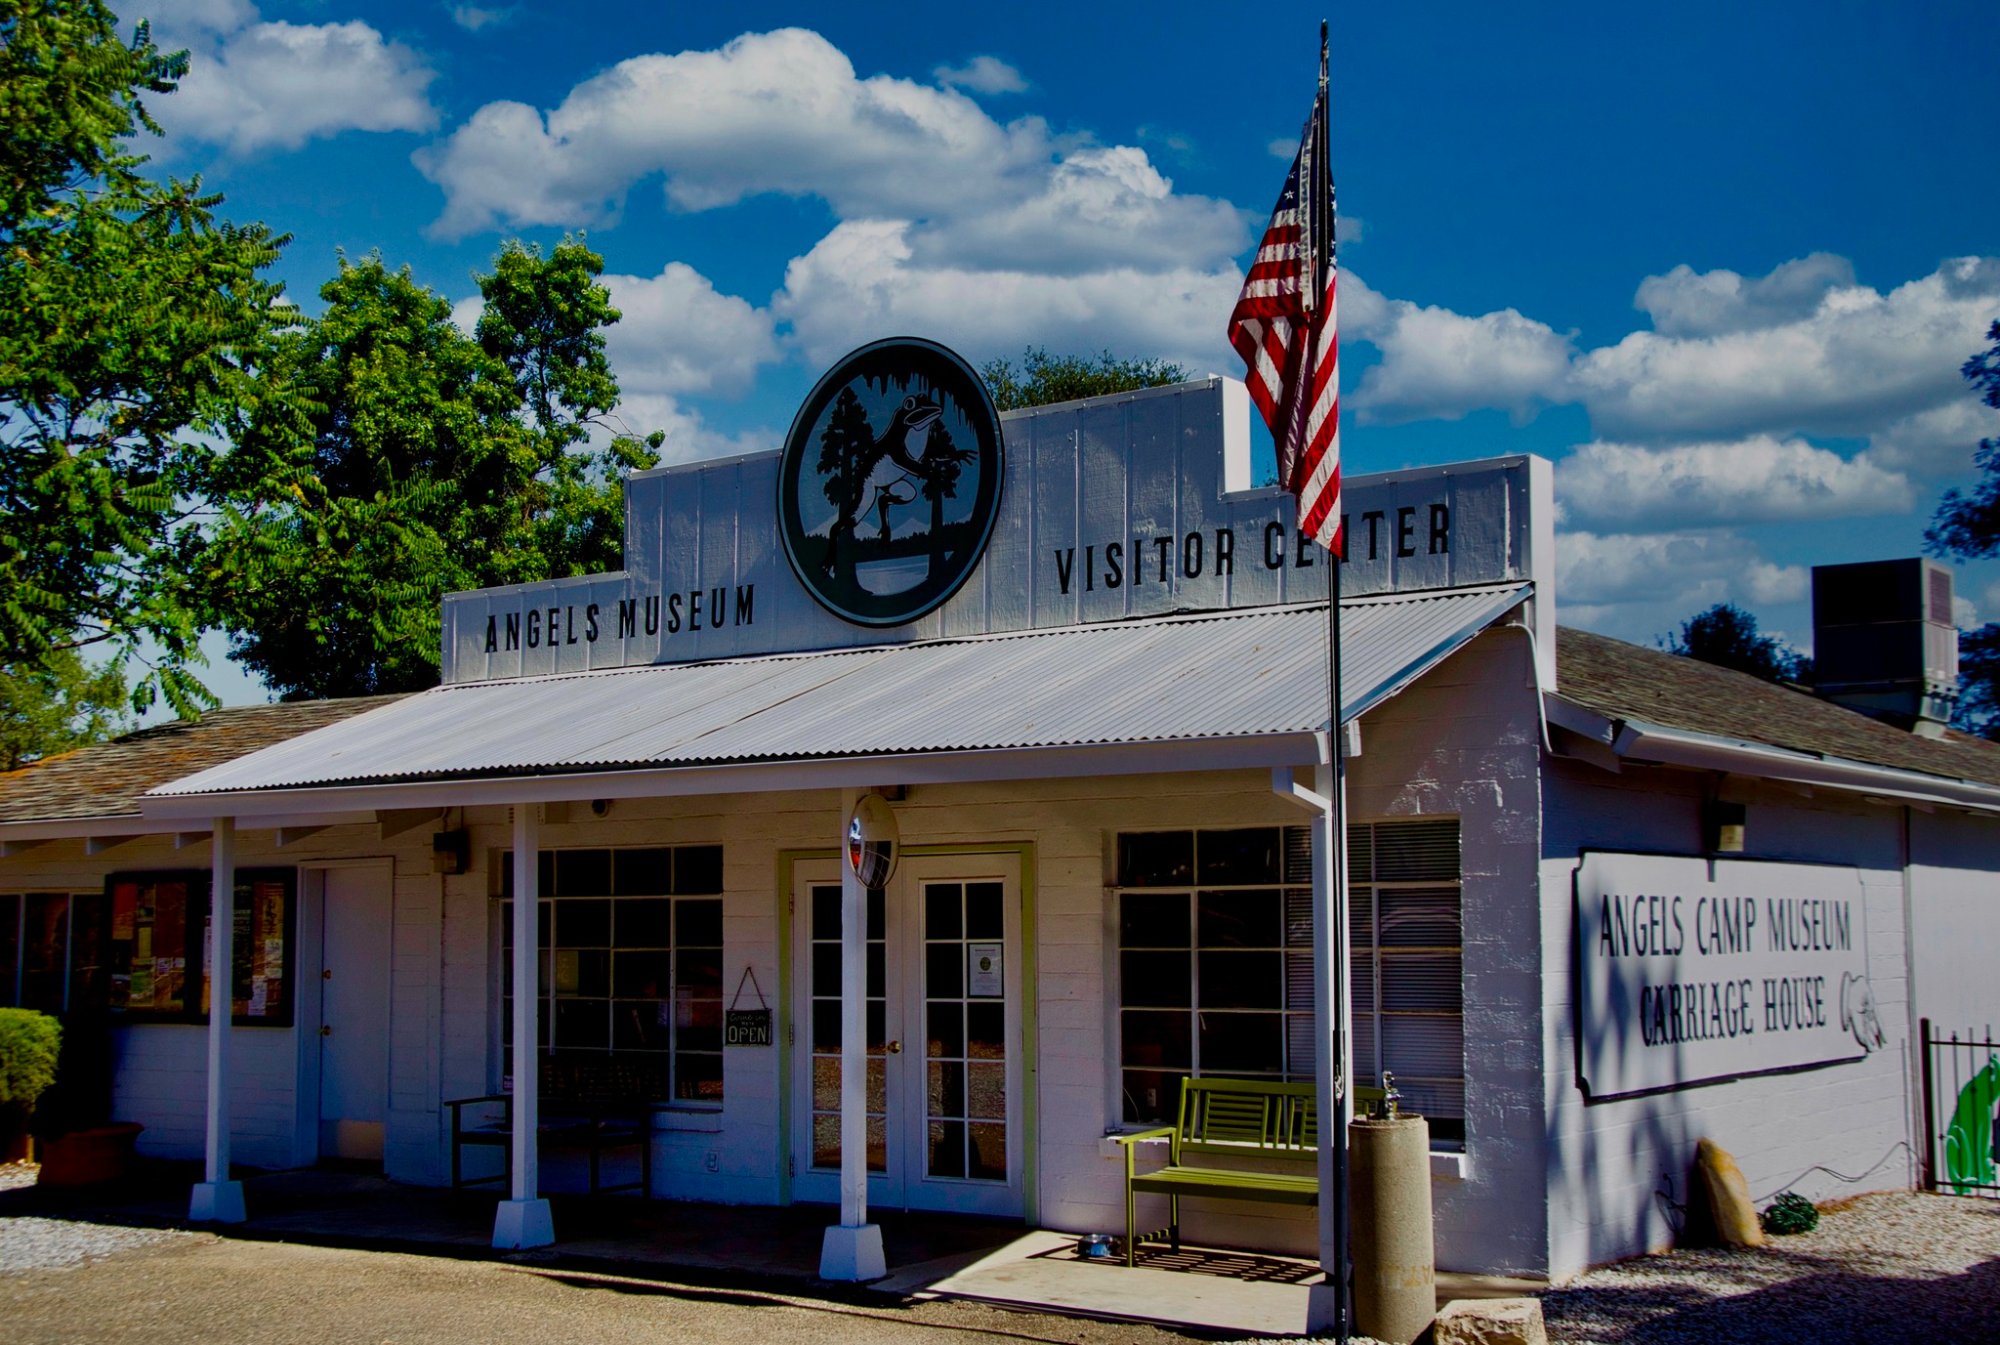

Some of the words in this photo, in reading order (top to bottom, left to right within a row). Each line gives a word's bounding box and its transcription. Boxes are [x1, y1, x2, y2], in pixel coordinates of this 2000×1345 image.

[1054, 528, 1235, 595] VISITOR
[484, 603, 600, 653] ANGELS
[618, 584, 755, 639] MUSEUM
[1600, 894, 1684, 958] ANGELS
[1696, 896, 1756, 956] CAMP
[1767, 898, 1851, 952] MUSEUM
[728, 1025, 767, 1043] OPEN
[1639, 978, 1755, 1048] CARRIAGE
[1763, 975, 1826, 1032] HOUSE
